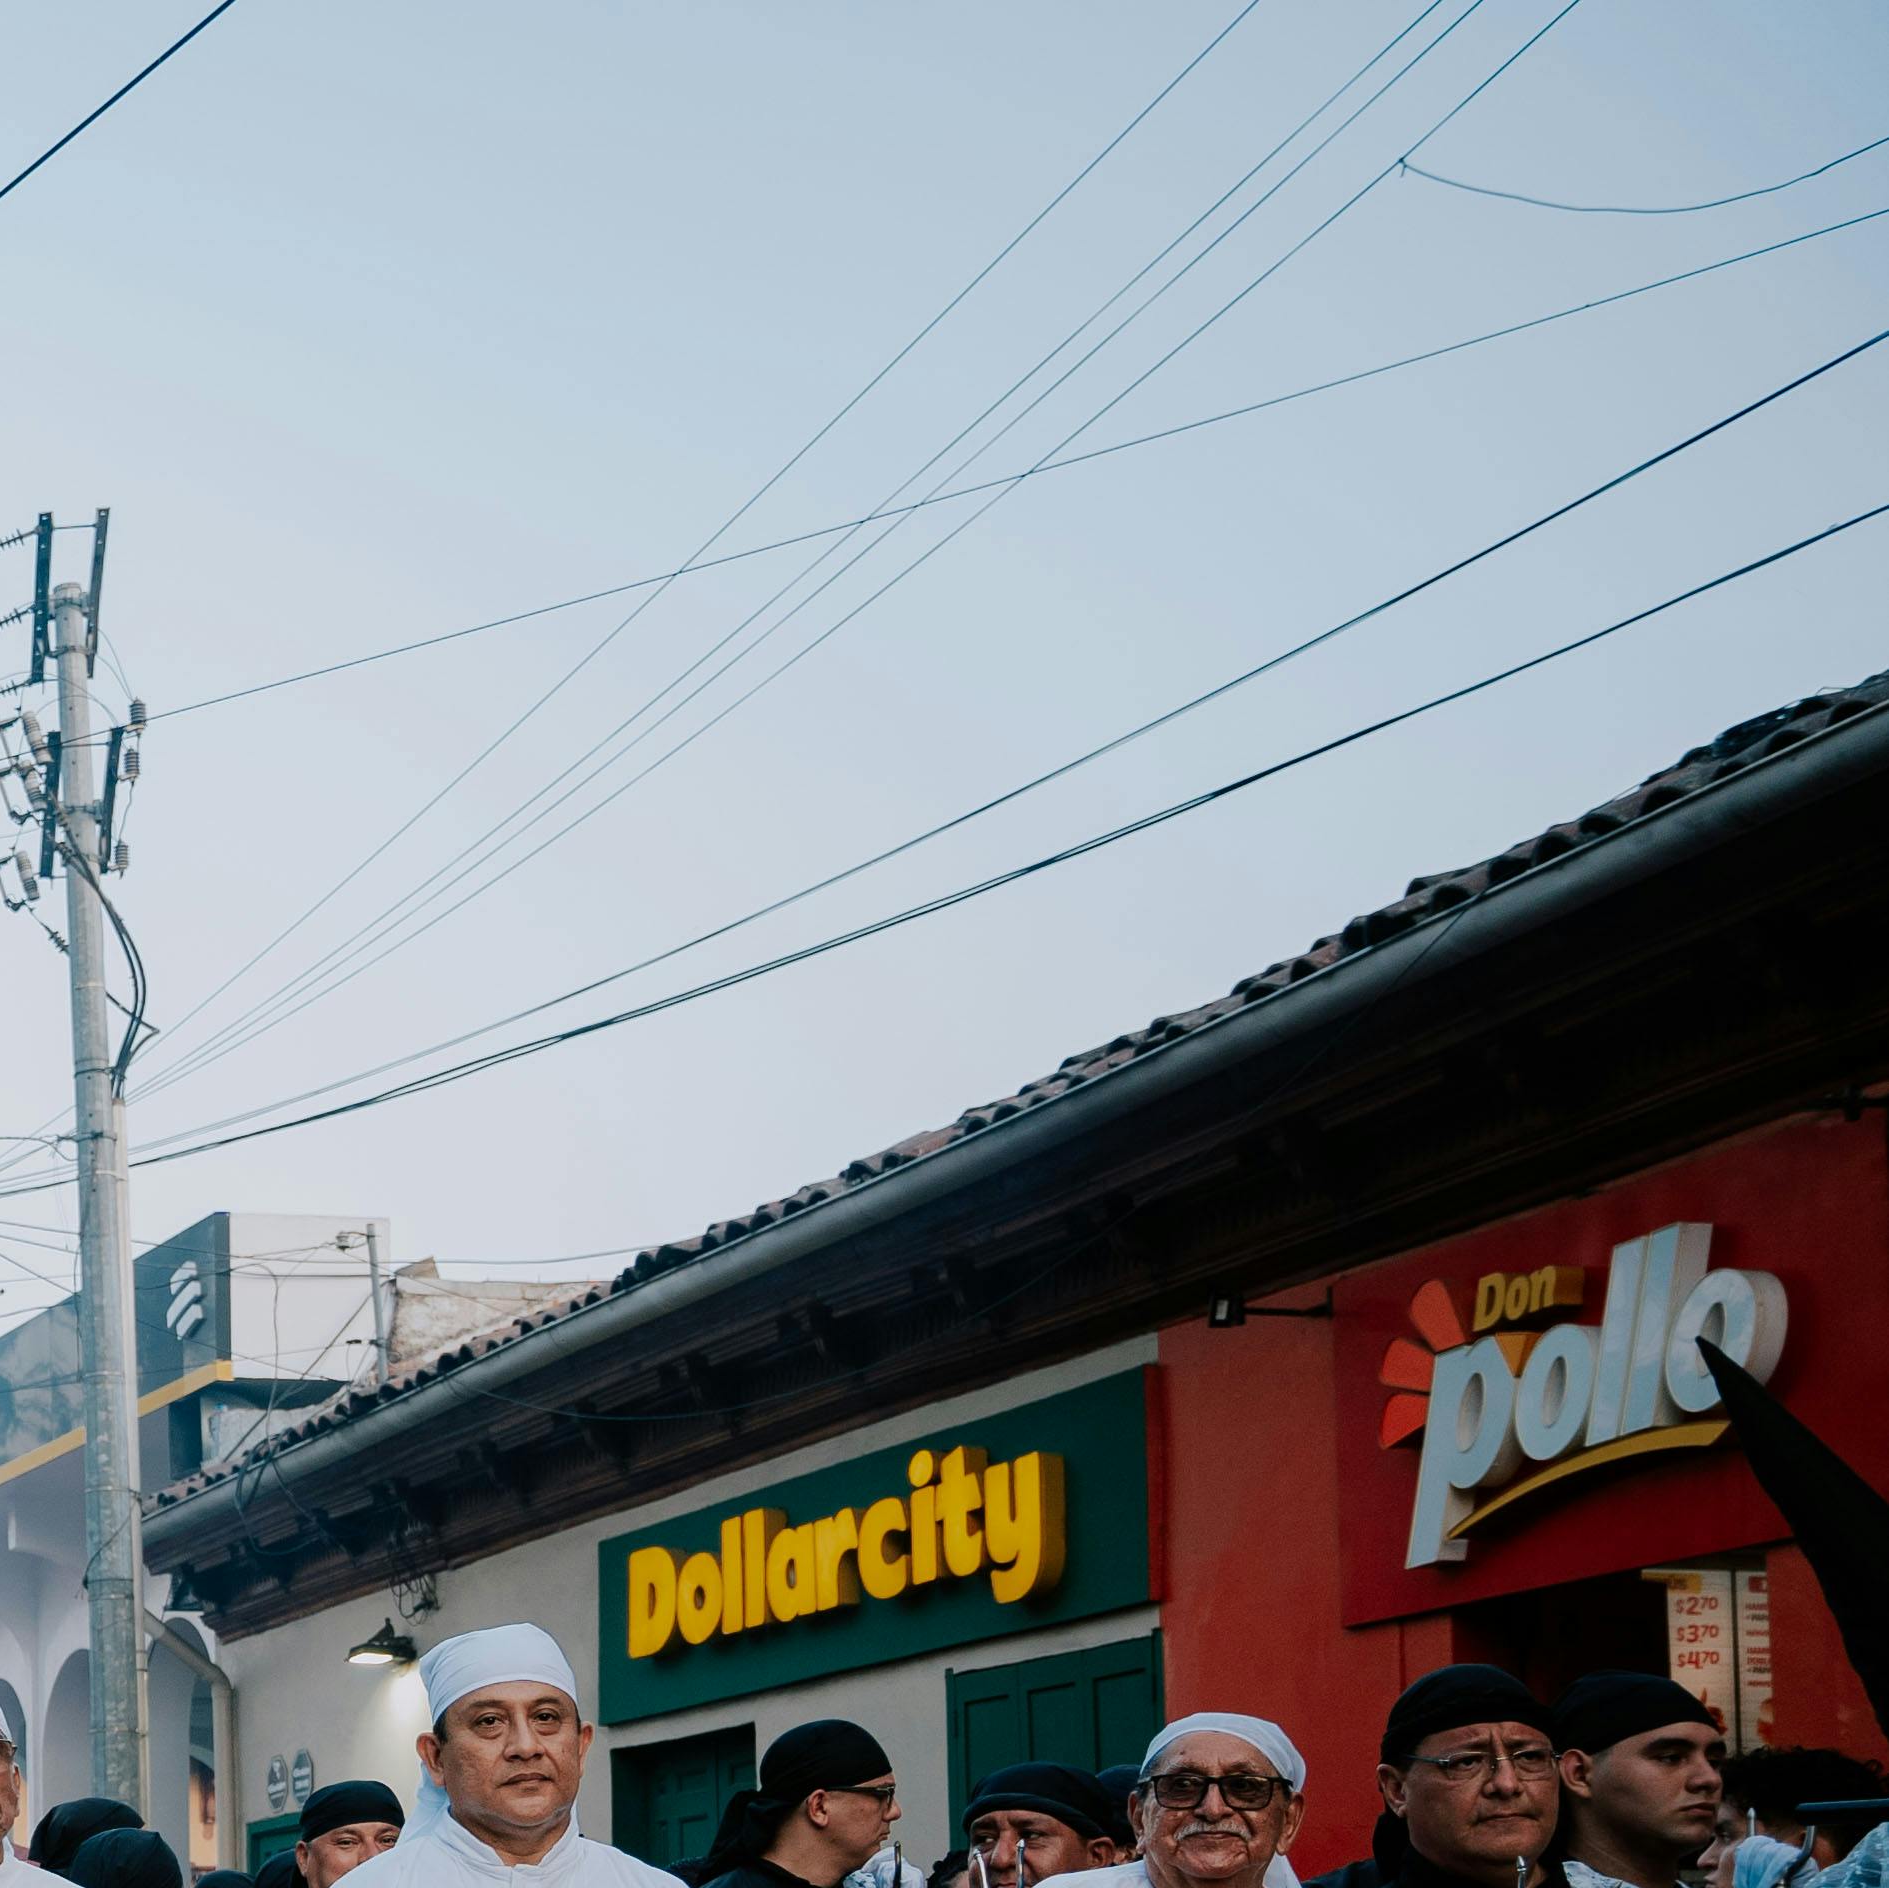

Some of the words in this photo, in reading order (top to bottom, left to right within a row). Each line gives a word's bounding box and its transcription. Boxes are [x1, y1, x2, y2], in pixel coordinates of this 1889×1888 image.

[1406, 1222, 1778, 1570] pollo
[1473, 1266, 1557, 1332] Don
[628, 1444, 1064, 1660] Dollarcity
